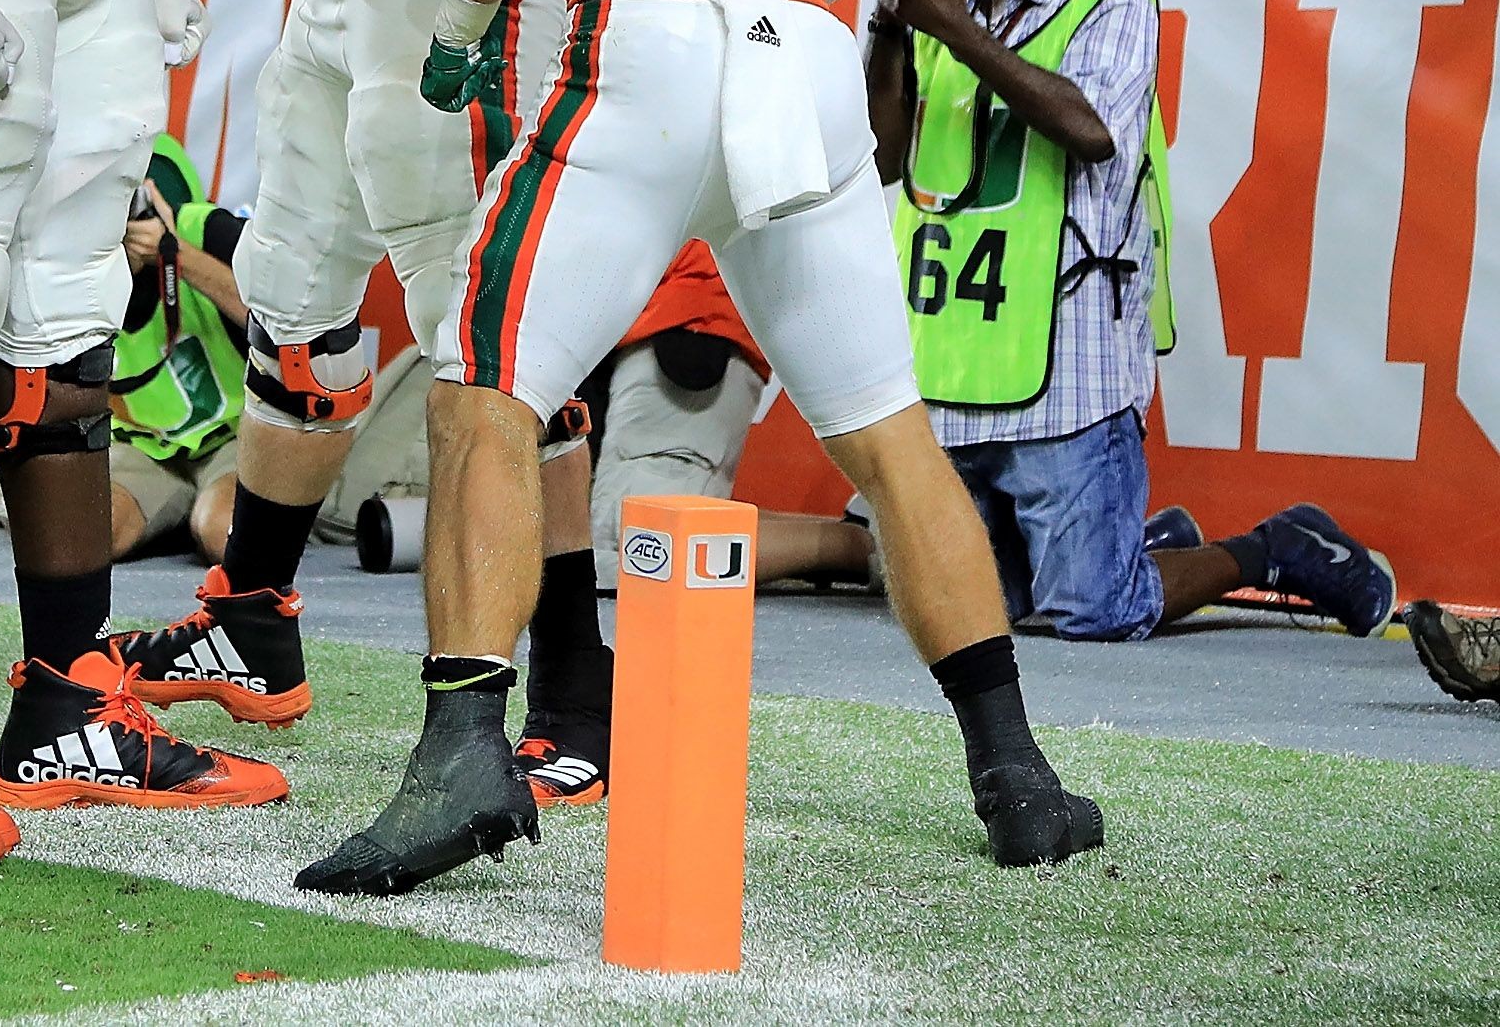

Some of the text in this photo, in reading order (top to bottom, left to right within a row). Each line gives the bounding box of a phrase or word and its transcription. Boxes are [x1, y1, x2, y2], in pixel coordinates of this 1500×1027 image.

[747, 31, 781, 47] adidas
[164, 264, 177, 306] Canon
[908, 223, 1007, 322] 64
[631, 543, 662, 560] ACC
[695, 542, 743, 580] U
[165, 667, 267, 695] adidas
[18, 760, 139, 790] adidas
